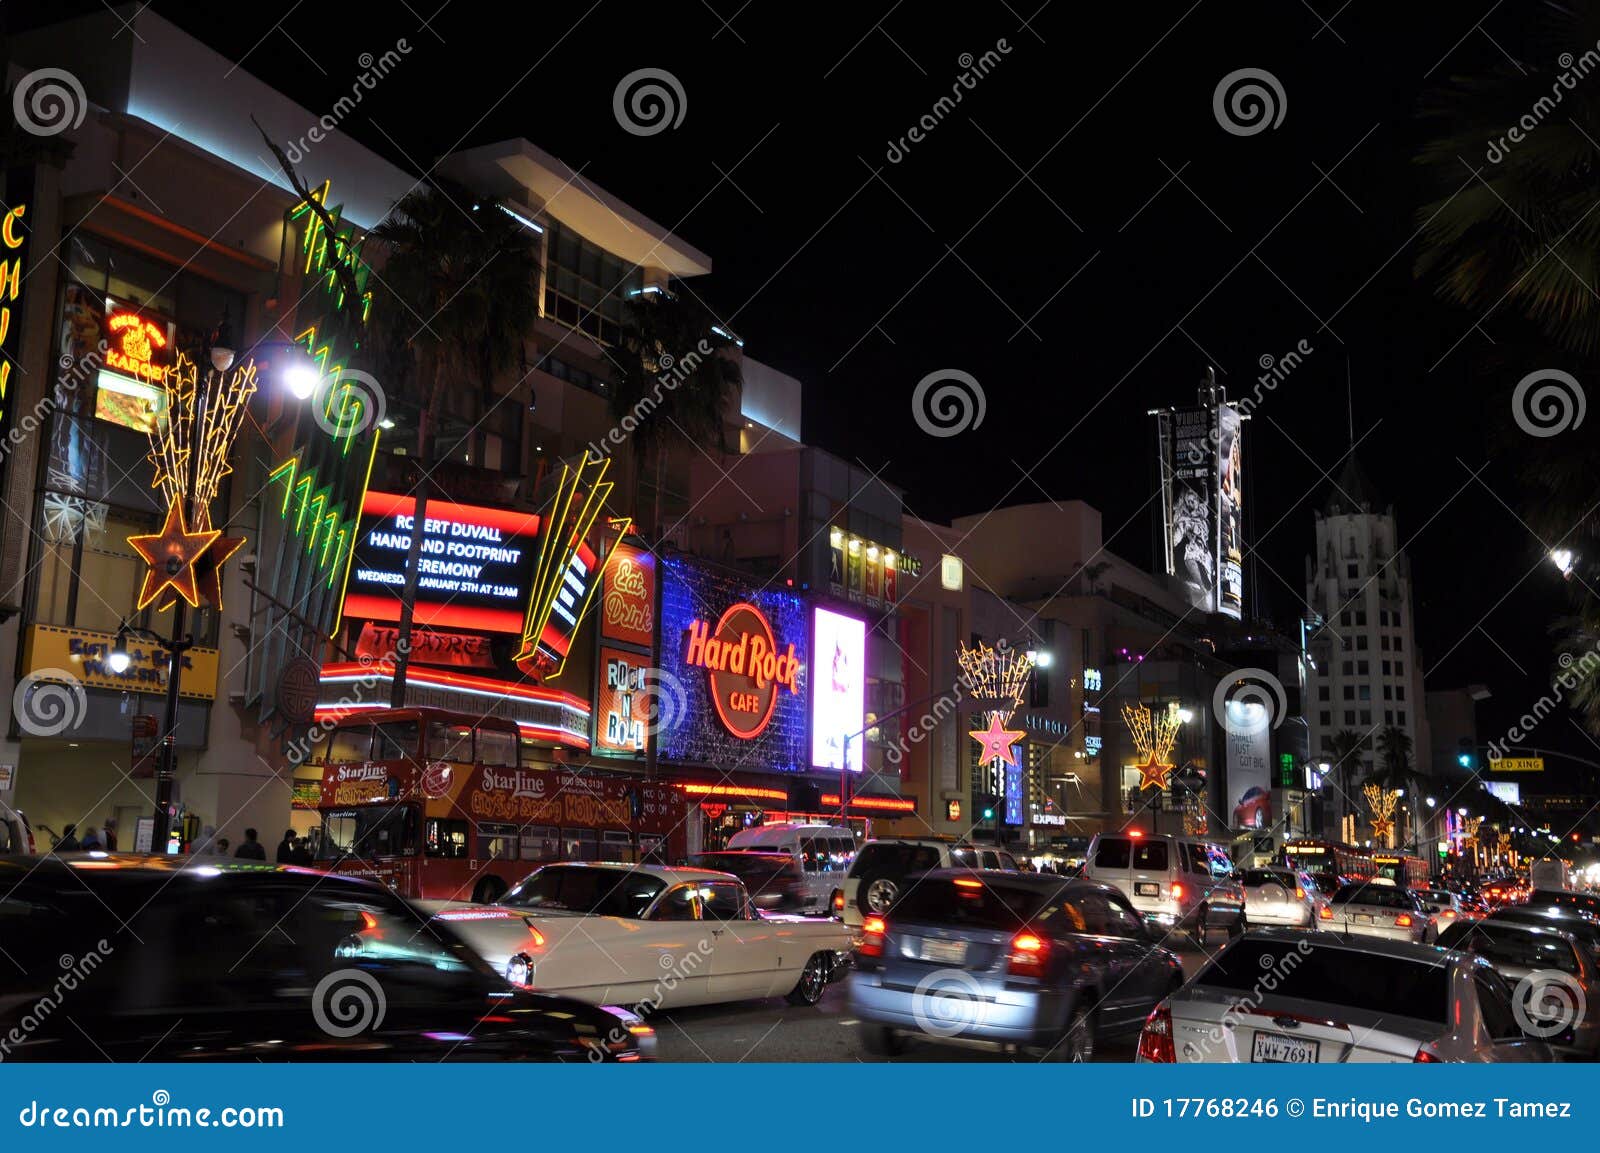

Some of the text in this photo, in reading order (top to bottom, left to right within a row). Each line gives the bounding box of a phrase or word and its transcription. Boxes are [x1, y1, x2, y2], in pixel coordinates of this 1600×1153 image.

[395, 514, 502, 542] ROERT DUVALL
[370, 531, 412, 550] HAND
[447, 541, 521, 563] FOOTPRINT
[405, 558, 483, 578] EREMONY
[419, 577, 460, 591] JANUARY
[461, 581, 479, 593] 5TH
[480, 583, 493, 595] AT
[493, 586, 518, 598] 11AM
[606, 591, 652, 633] Drink
[686, 618, 800, 696] Hard Rock
[607, 661, 647, 691] ROCK
[729, 691, 760, 714] CAFE
[607, 710, 644, 749] ROLL
[1239, 756, 1253, 768] GOT
[1493, 760, 1540, 770] PED XING
